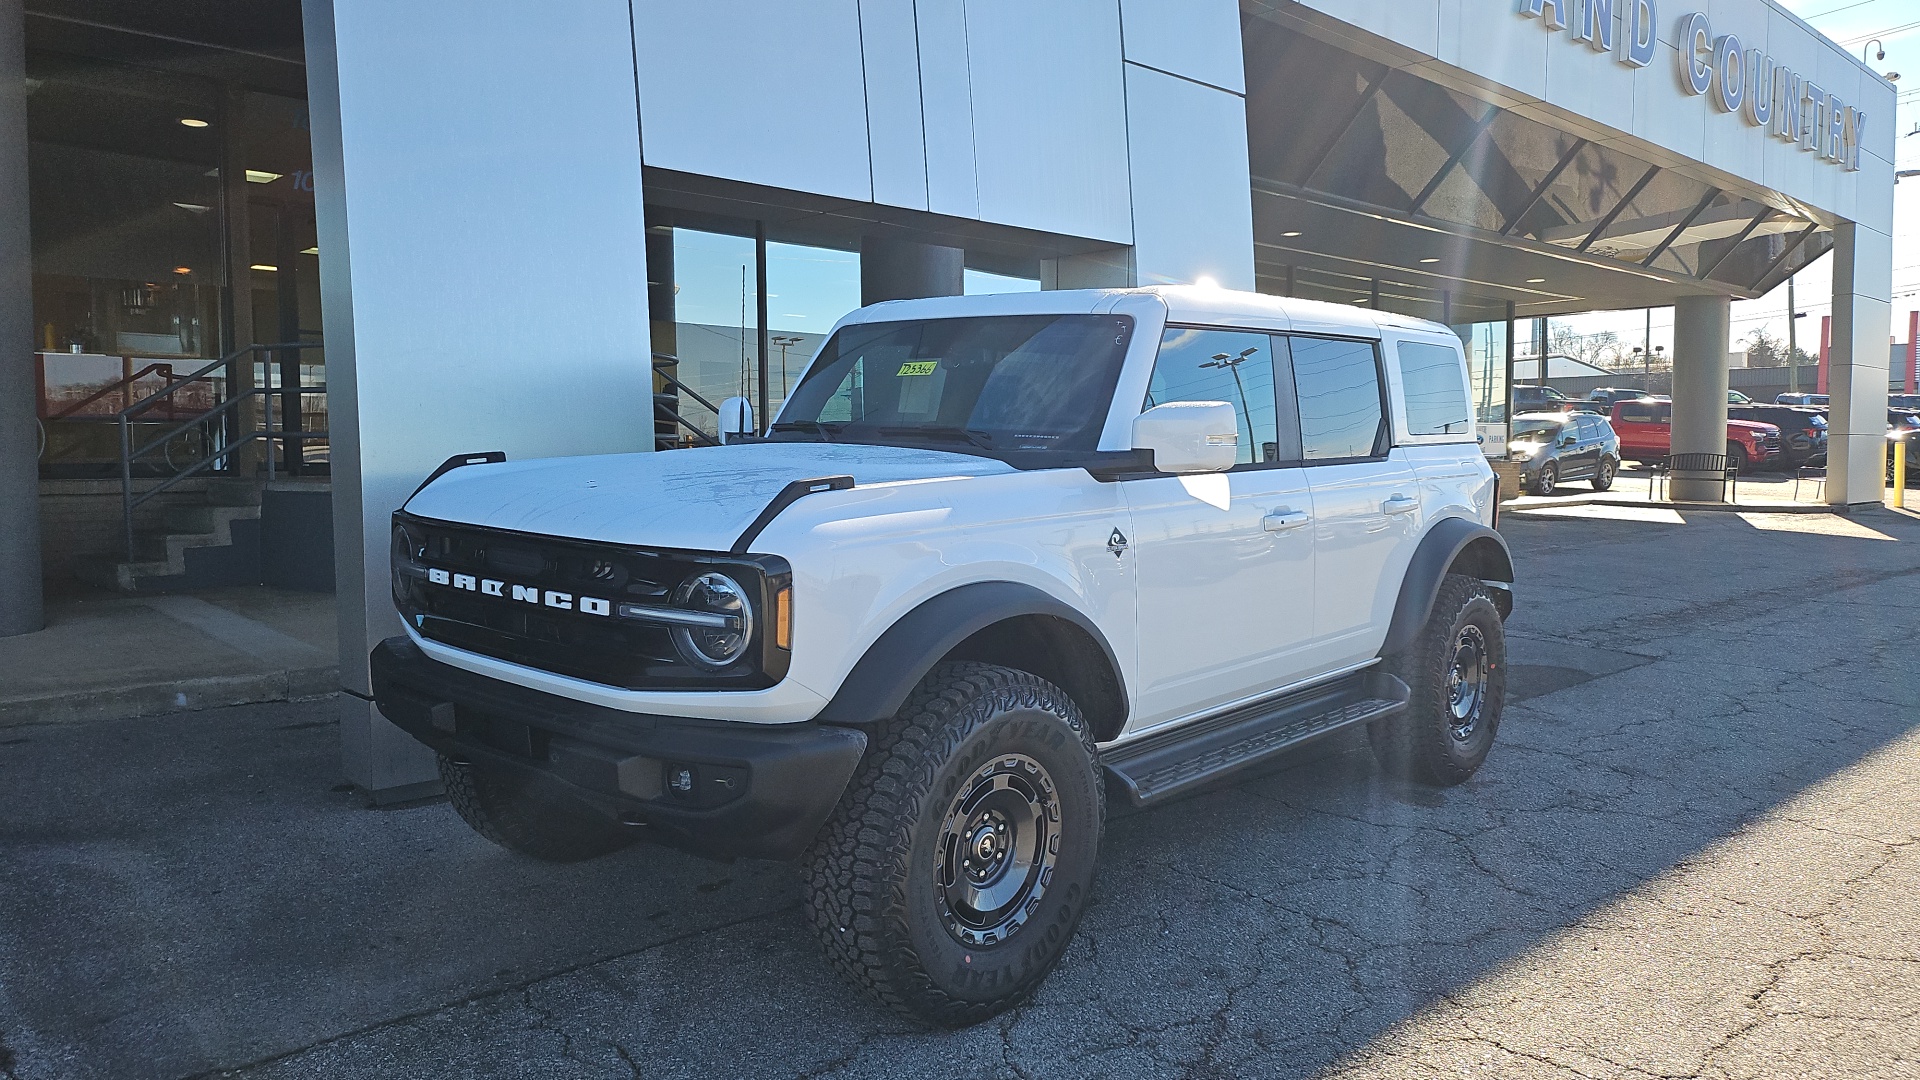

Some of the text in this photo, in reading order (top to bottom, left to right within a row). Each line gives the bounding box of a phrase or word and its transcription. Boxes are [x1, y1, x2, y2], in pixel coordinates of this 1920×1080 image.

[1679, 12, 1866, 171] COUNTRY
[428, 567, 610, 617] BRONCO
[933, 719, 1066, 821] GOODYEAR
